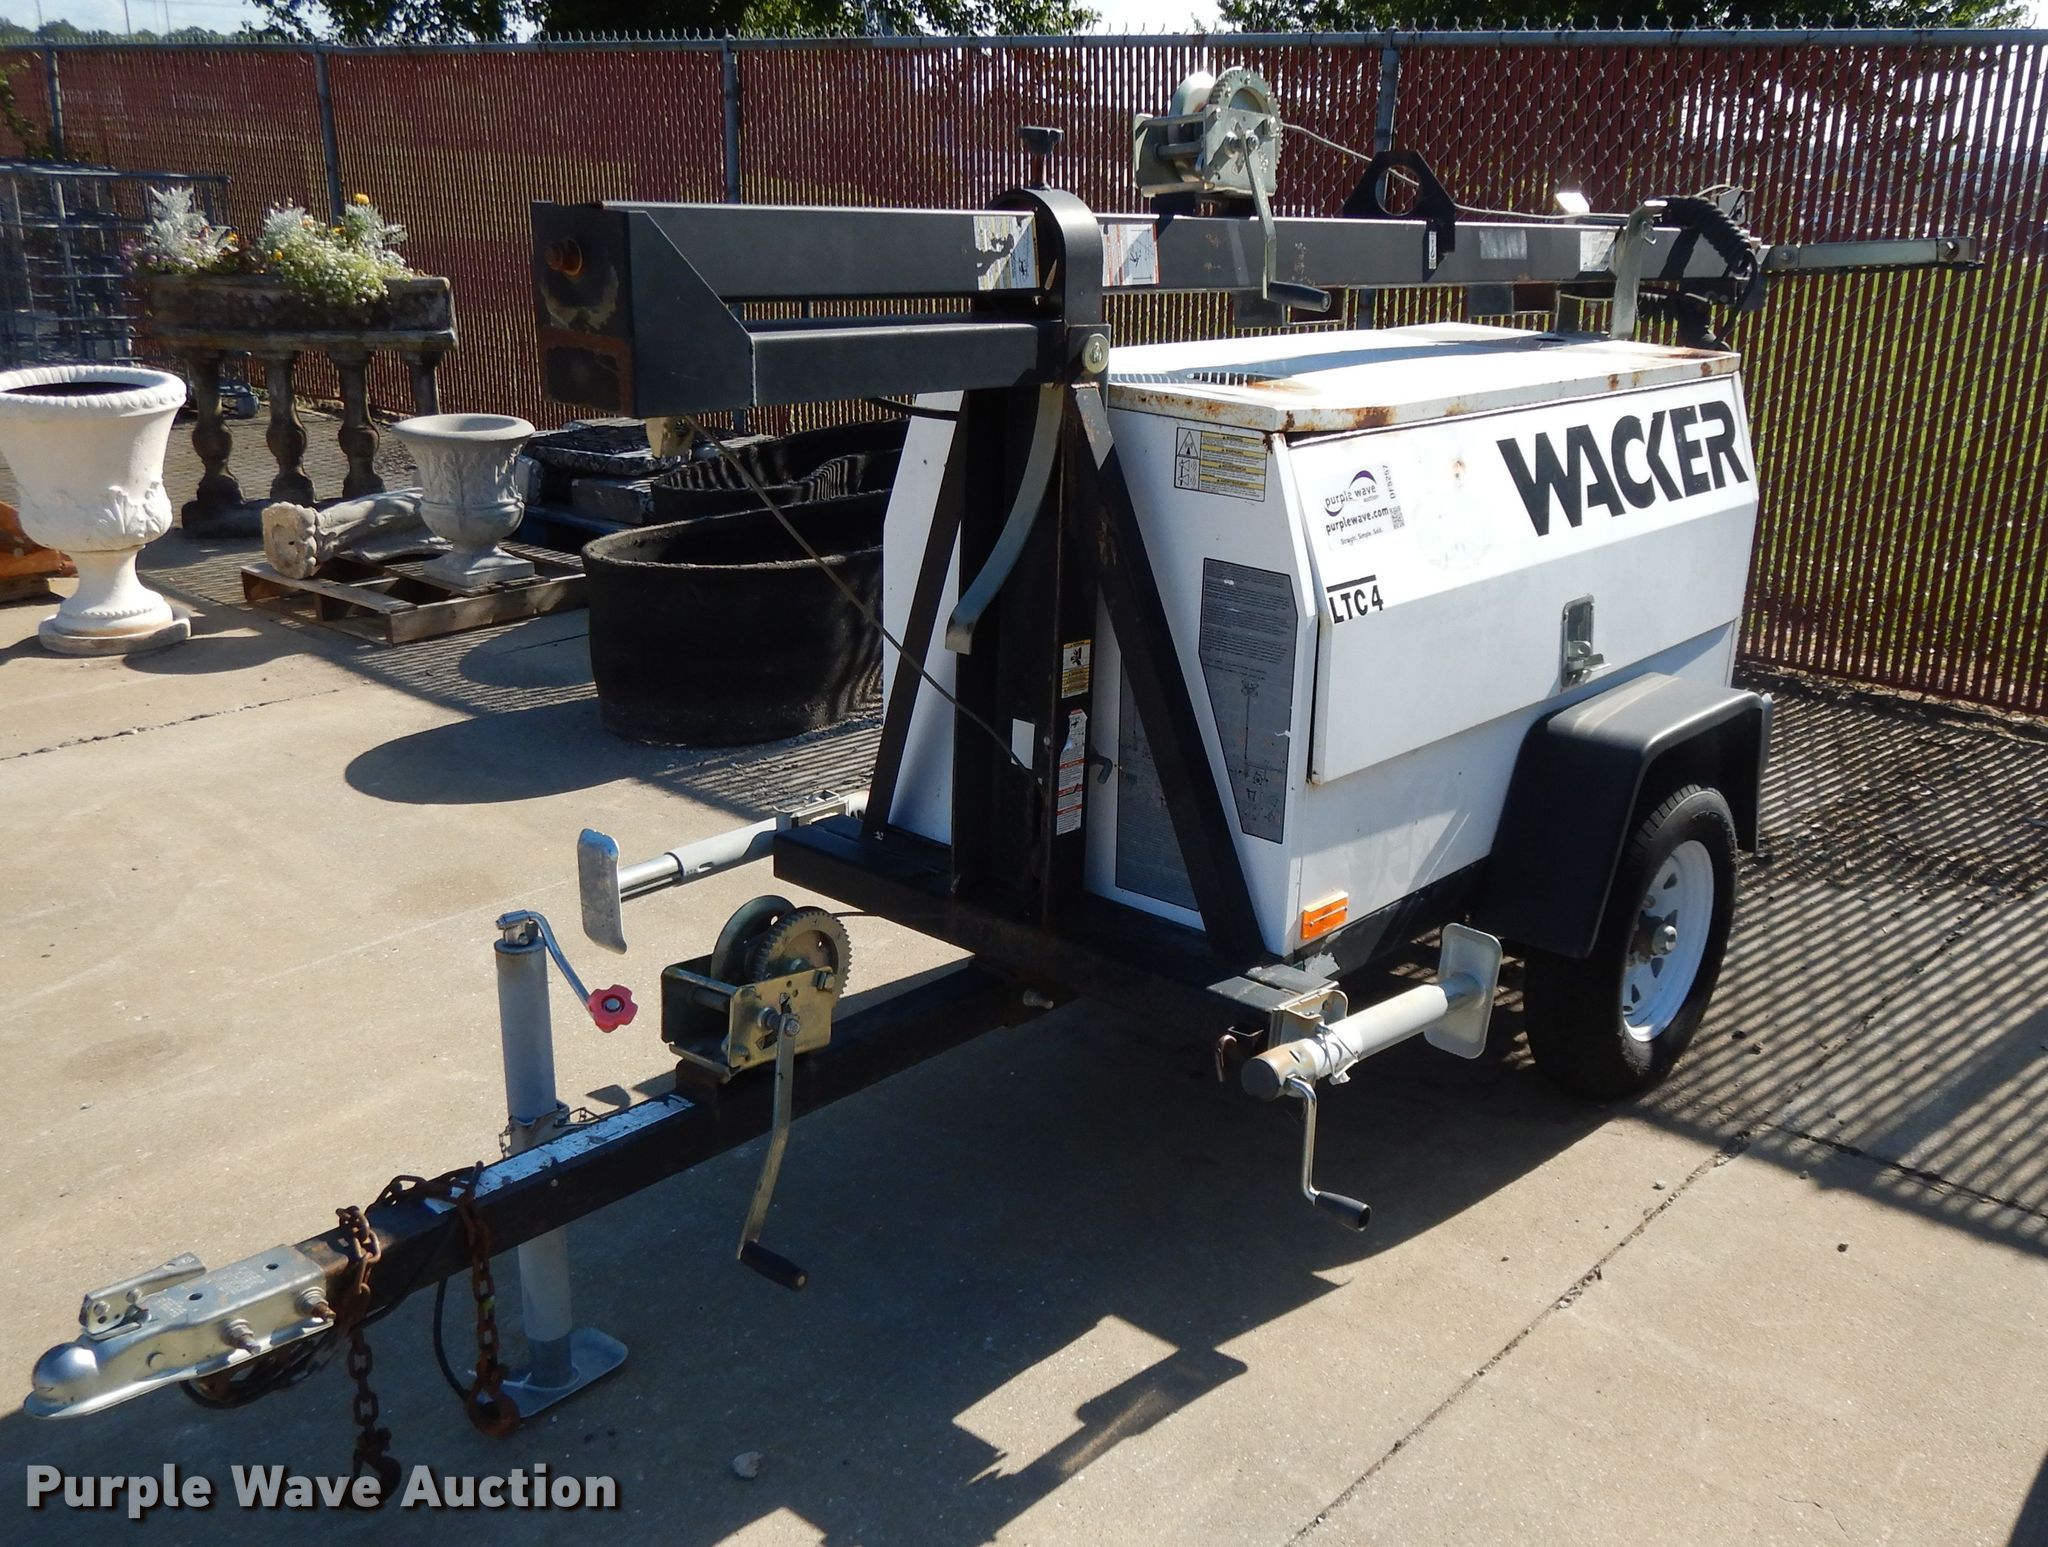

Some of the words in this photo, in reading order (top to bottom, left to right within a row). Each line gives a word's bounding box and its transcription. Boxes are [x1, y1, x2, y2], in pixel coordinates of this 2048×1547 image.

[1496, 400, 1749, 536] WACKER
[1324, 490, 1353, 507] purple
[1354, 484, 1377, 498] wave
[1325, 507, 1389, 536] purplewave.com
[1329, 585, 1384, 624] LTC4
